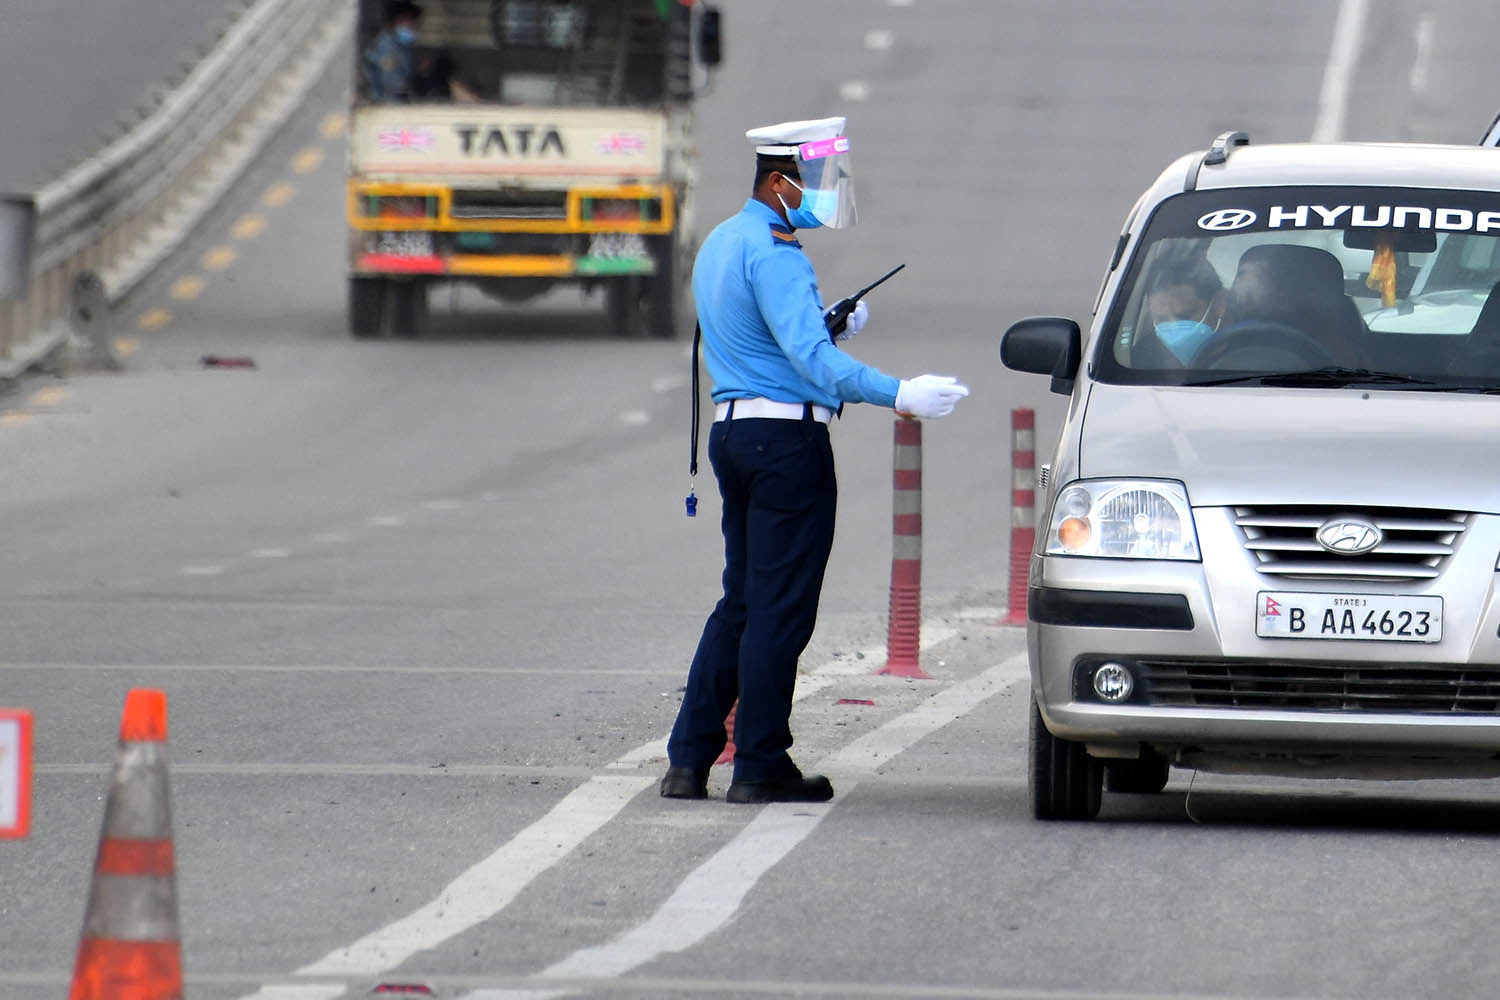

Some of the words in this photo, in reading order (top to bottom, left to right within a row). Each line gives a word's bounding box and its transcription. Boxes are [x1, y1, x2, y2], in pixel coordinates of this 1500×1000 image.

[455, 123, 566, 155] TATA
[1334, 598, 1360, 607] STATE
[1362, 599, 1367, 607] 3
[1289, 607, 1306, 633] B
